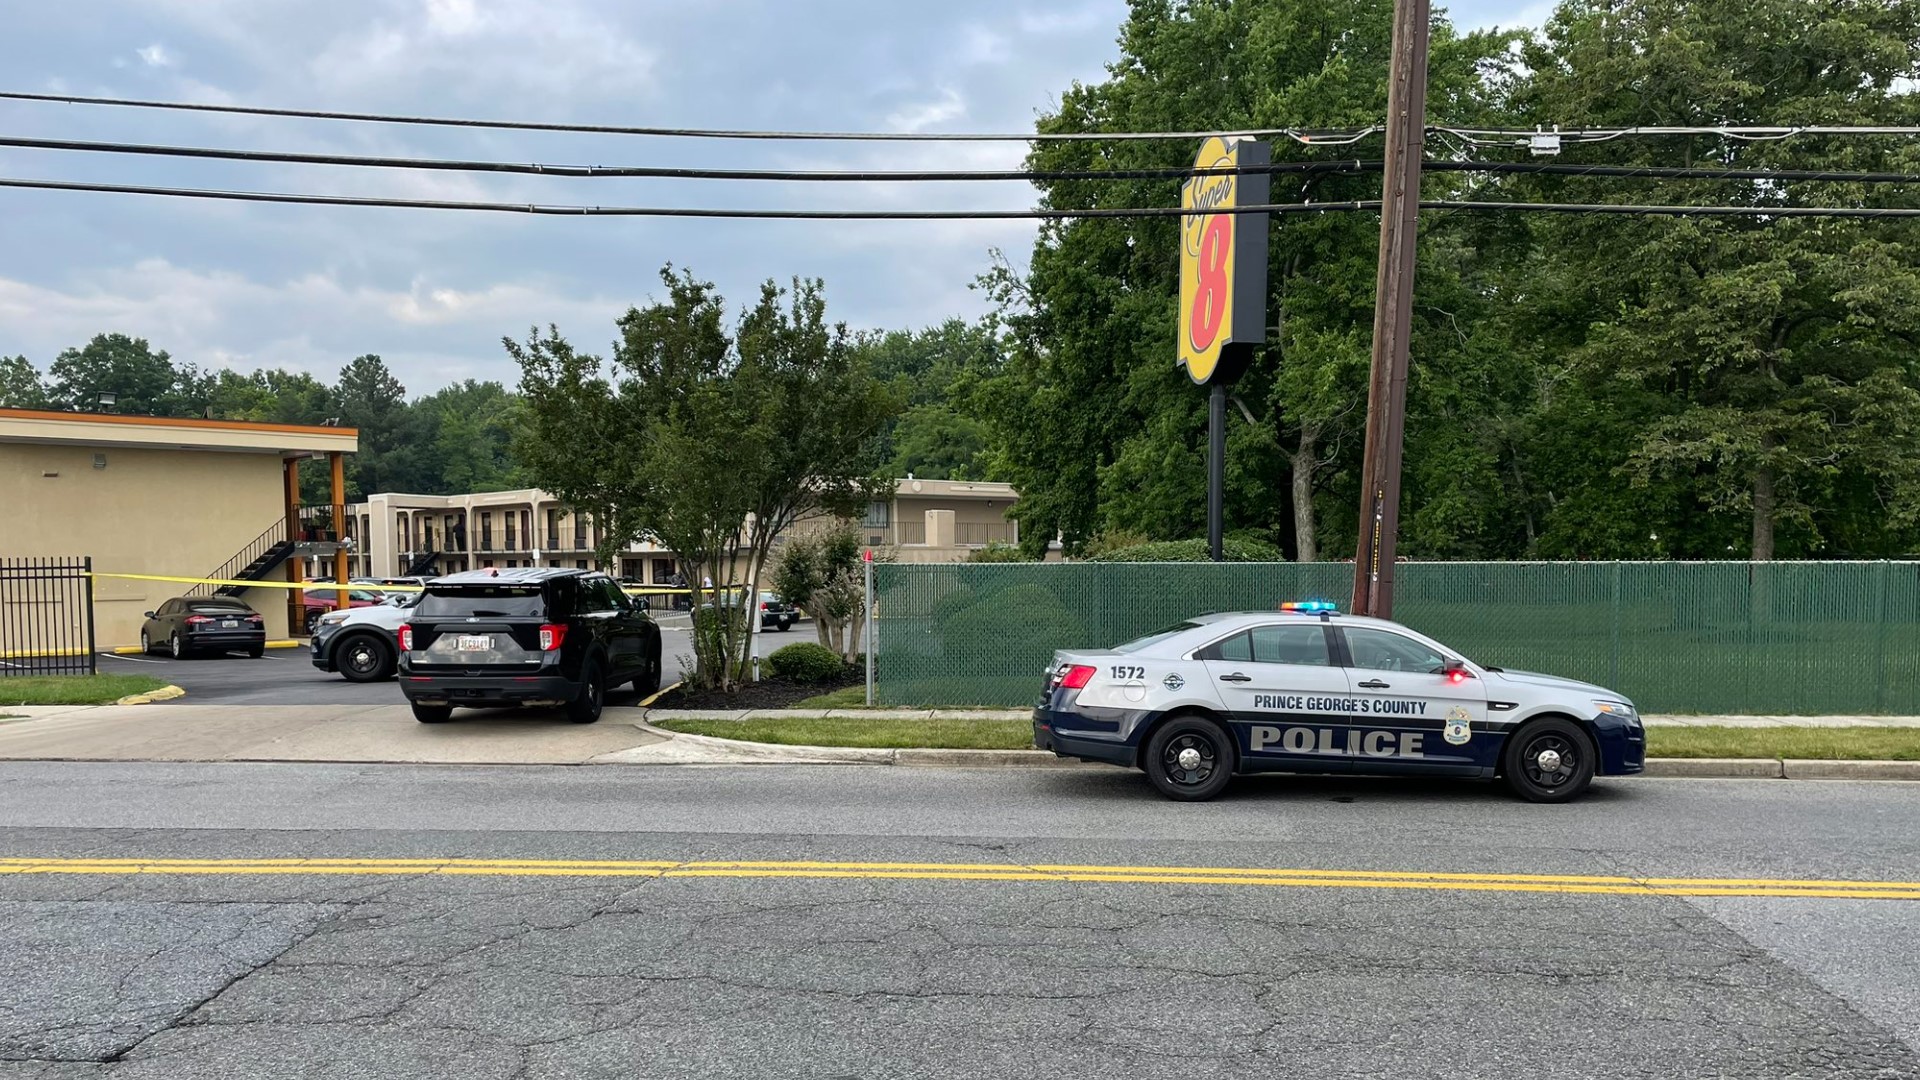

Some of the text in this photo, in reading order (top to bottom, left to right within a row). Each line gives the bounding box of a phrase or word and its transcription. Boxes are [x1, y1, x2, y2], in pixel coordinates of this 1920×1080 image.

[1187, 160, 1233, 254] Super
[1190, 213, 1231, 352] 8
[1111, 666, 1145, 679] 1572
[1254, 694, 1427, 715] PRINCE GEORGE'S COUNTY
[1250, 726, 1424, 758] POLICE
